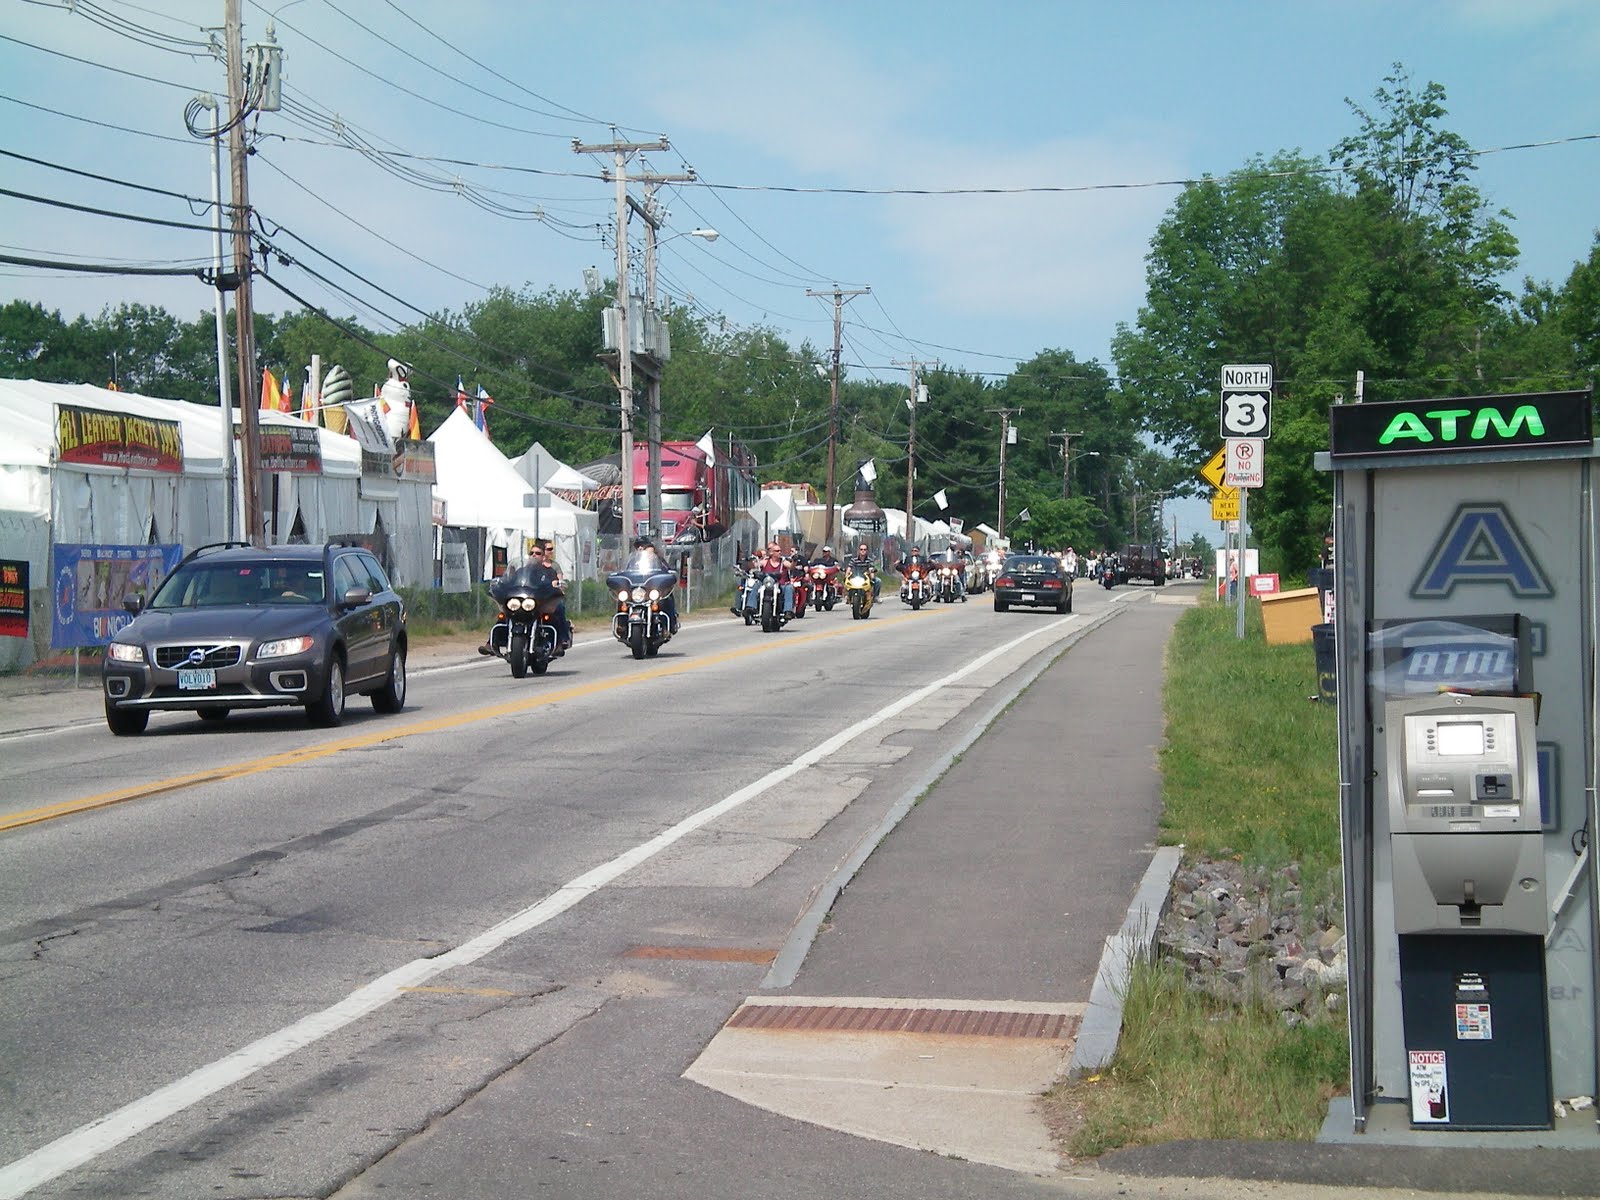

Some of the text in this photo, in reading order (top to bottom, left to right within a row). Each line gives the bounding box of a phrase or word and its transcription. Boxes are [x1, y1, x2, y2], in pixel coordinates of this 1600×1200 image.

[1225, 370, 1268, 385] NORTH
[1237, 403, 1255, 426] 3
[61, 410, 78, 455] ALL
[80, 411, 122, 445] LEATHER
[124, 416, 159, 449] JACKETS
[1378, 405, 1546, 445] ATM
[1238, 461, 1251, 470] NO
[1408, 649, 1508, 676] ATM
[1411, 1053, 1444, 1063] NOTICE
[1412, 1071, 1433, 1079] Protected
